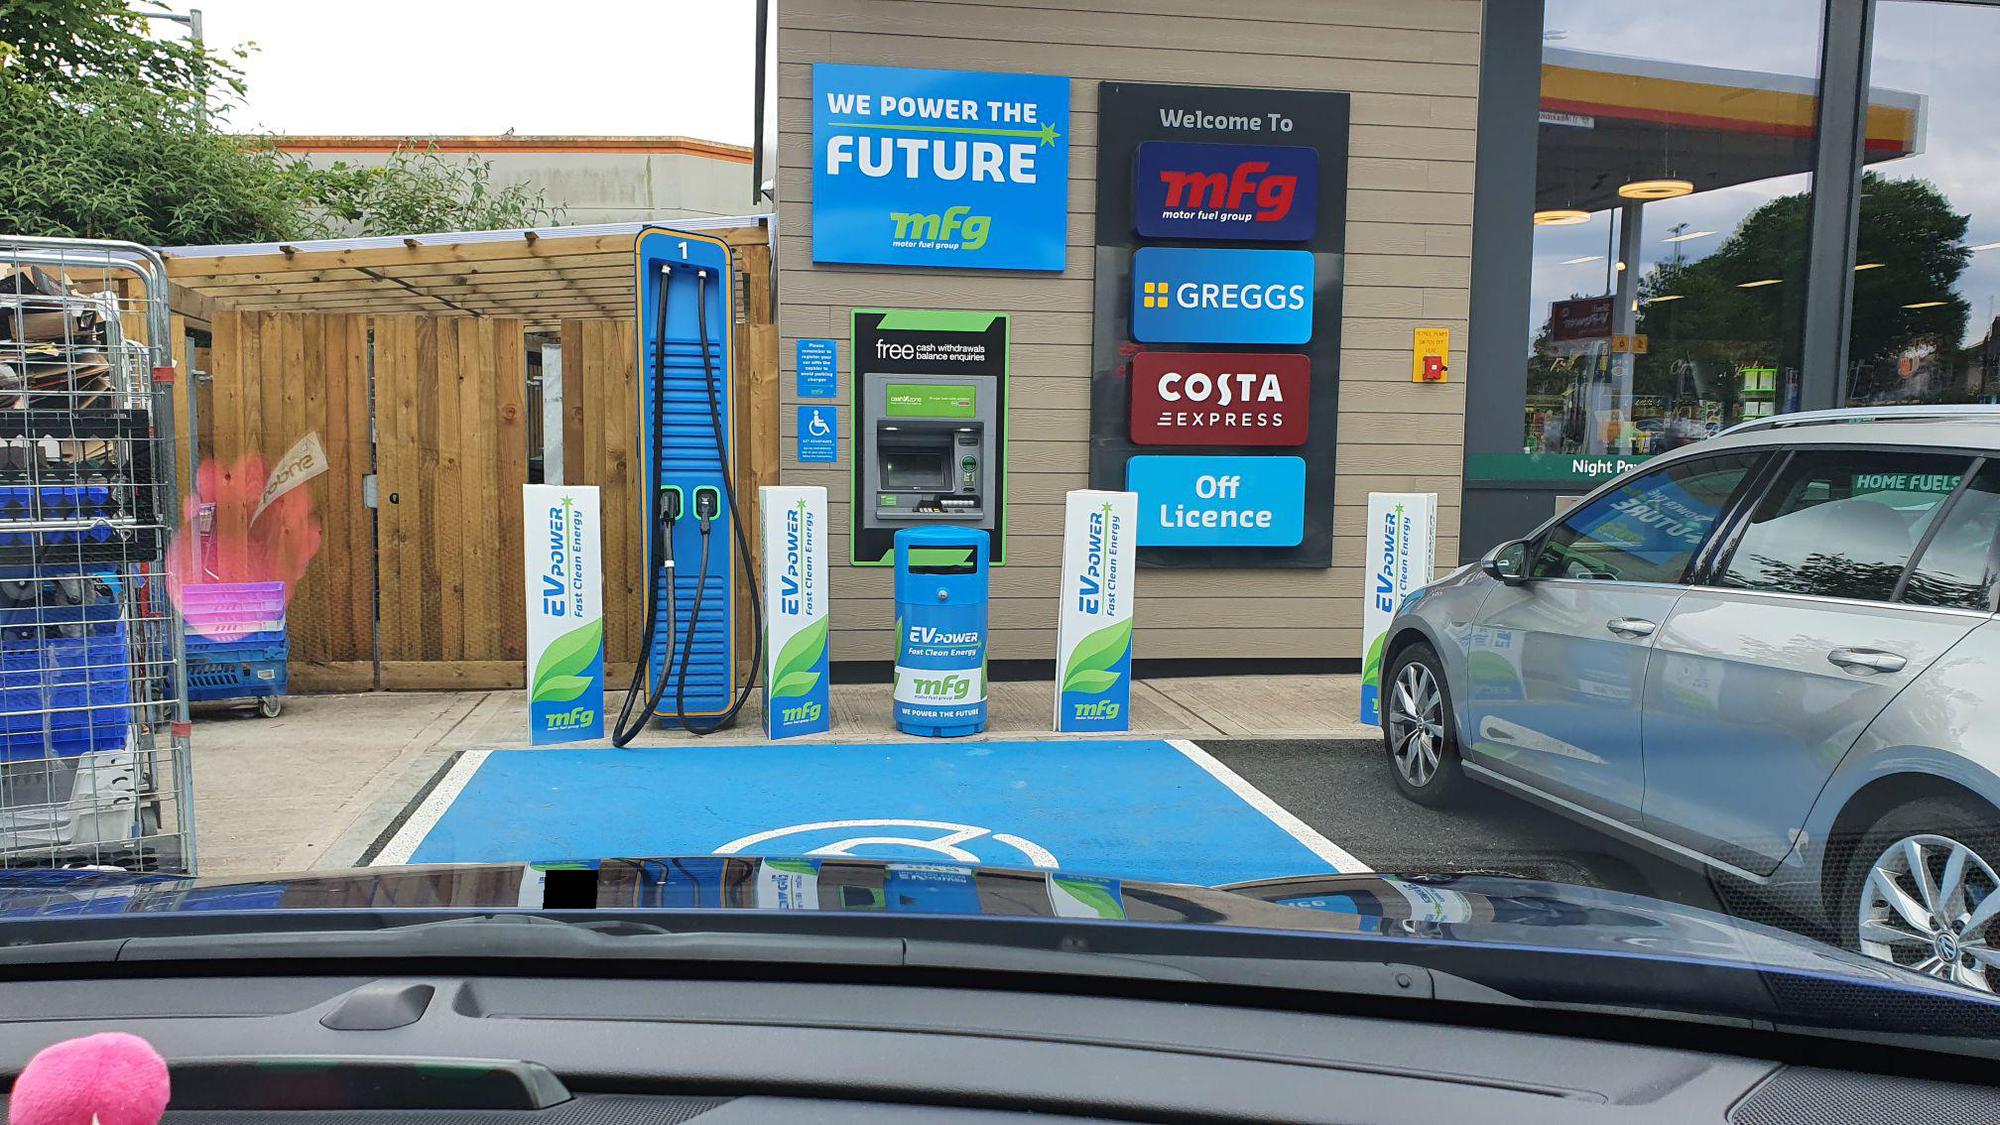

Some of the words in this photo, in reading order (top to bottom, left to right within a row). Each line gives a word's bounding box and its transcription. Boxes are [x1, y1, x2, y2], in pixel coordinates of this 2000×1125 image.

[827, 92, 871, 115] WE
[880, 95, 979, 121] POWER
[987, 101, 1038, 124] THE
[1160, 109, 1262, 131] Welcome
[1267, 113, 1293, 132] To
[826, 135, 1038, 184] FUTURE
[1160, 162, 1298, 222] mfg
[890, 206, 992, 250] mfg
[1162, 211, 1196, 220] motor
[1197, 210, 1218, 221] fuel
[1220, 212, 1252, 223] group
[678, 241, 688, 260] 1
[919, 241, 934, 249] fuel
[1177, 283, 1305, 310] GREGGS
[876, 339, 914, 360] free
[916, 343, 936, 352] cash
[937, 344, 985, 353] withdrawals
[916, 352, 948, 360] balance
[949, 353, 985, 362] enquiries
[1158, 372, 1283, 406] COSTA
[1177, 412, 1283, 427] EXPRESS
[1572, 459, 1613, 477] Night
[1616, 460, 1637, 474] Pa
[1196, 475, 1241, 499] Off
[1857, 474, 1905, 489] HOME
[1909, 475, 1961, 491] FUELS
[1160, 504, 1272, 528] Licence
[573, 510, 583, 553] Energy
[804, 512, 814, 553] Energy
[1109, 515, 1121, 555] Energy
[1401, 517, 1411, 558] Energy
[573, 556, 583, 590] Clean
[805, 557, 813, 589] Clean
[1107, 558, 1117, 590] Clean
[1400, 561, 1408, 593] Clean
[574, 593, 583, 618] Fast
[805, 591, 813, 616] Fast
[1107, 593, 1116, 617] Fast
[908, 647, 924, 656] Fast
[925, 649, 949, 657] Clean
[950, 649, 977, 657] Energy
[913, 674, 970, 700] mfg
[546, 707, 594, 728] mfg
[782, 701, 821, 721] mfg
[912, 708, 938, 717] POWER
[940, 709, 954, 718] THE
[955, 708, 979, 717] FUTURE
[1074, 699, 1120, 719] mfg
